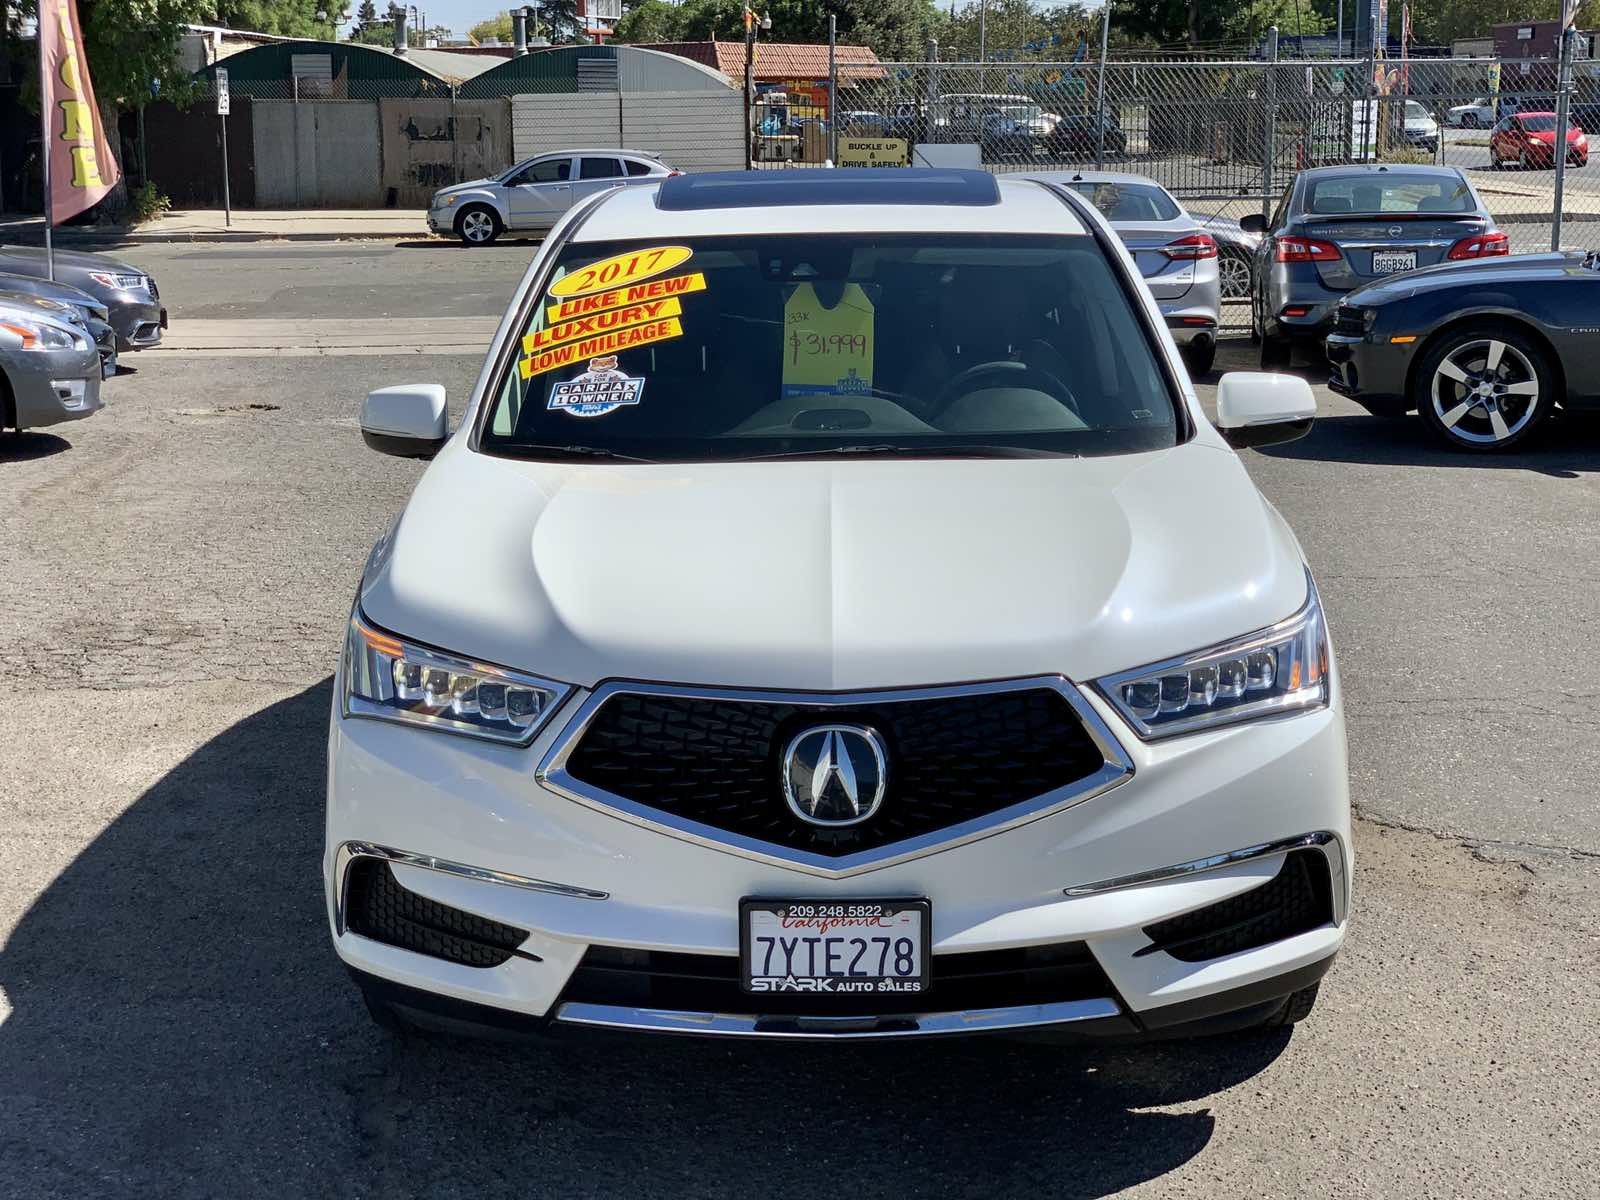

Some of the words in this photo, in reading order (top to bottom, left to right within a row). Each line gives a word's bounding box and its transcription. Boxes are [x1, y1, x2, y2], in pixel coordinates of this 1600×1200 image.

[575, 249, 667, 292] 2017
[1375, 258, 1414, 270] 8GGB961
[559, 291, 620, 318] LIKE
[627, 276, 692, 302] NEW
[533, 300, 668, 349] LUXURY
[529, 346, 577, 373] LOW
[578, 321, 672, 357] MILEAGE
[559, 382, 637, 394] CARFAX
[569, 393, 634, 403] OWNER
[789, 905, 882, 917] 209.248.5822
[782, 916, 893, 934] California
[756, 937, 914, 976] 7YTE278
[751, 974, 834, 992] STARK
[836, 982, 874, 992] AUTO
[878, 982, 921, 992] SALES
